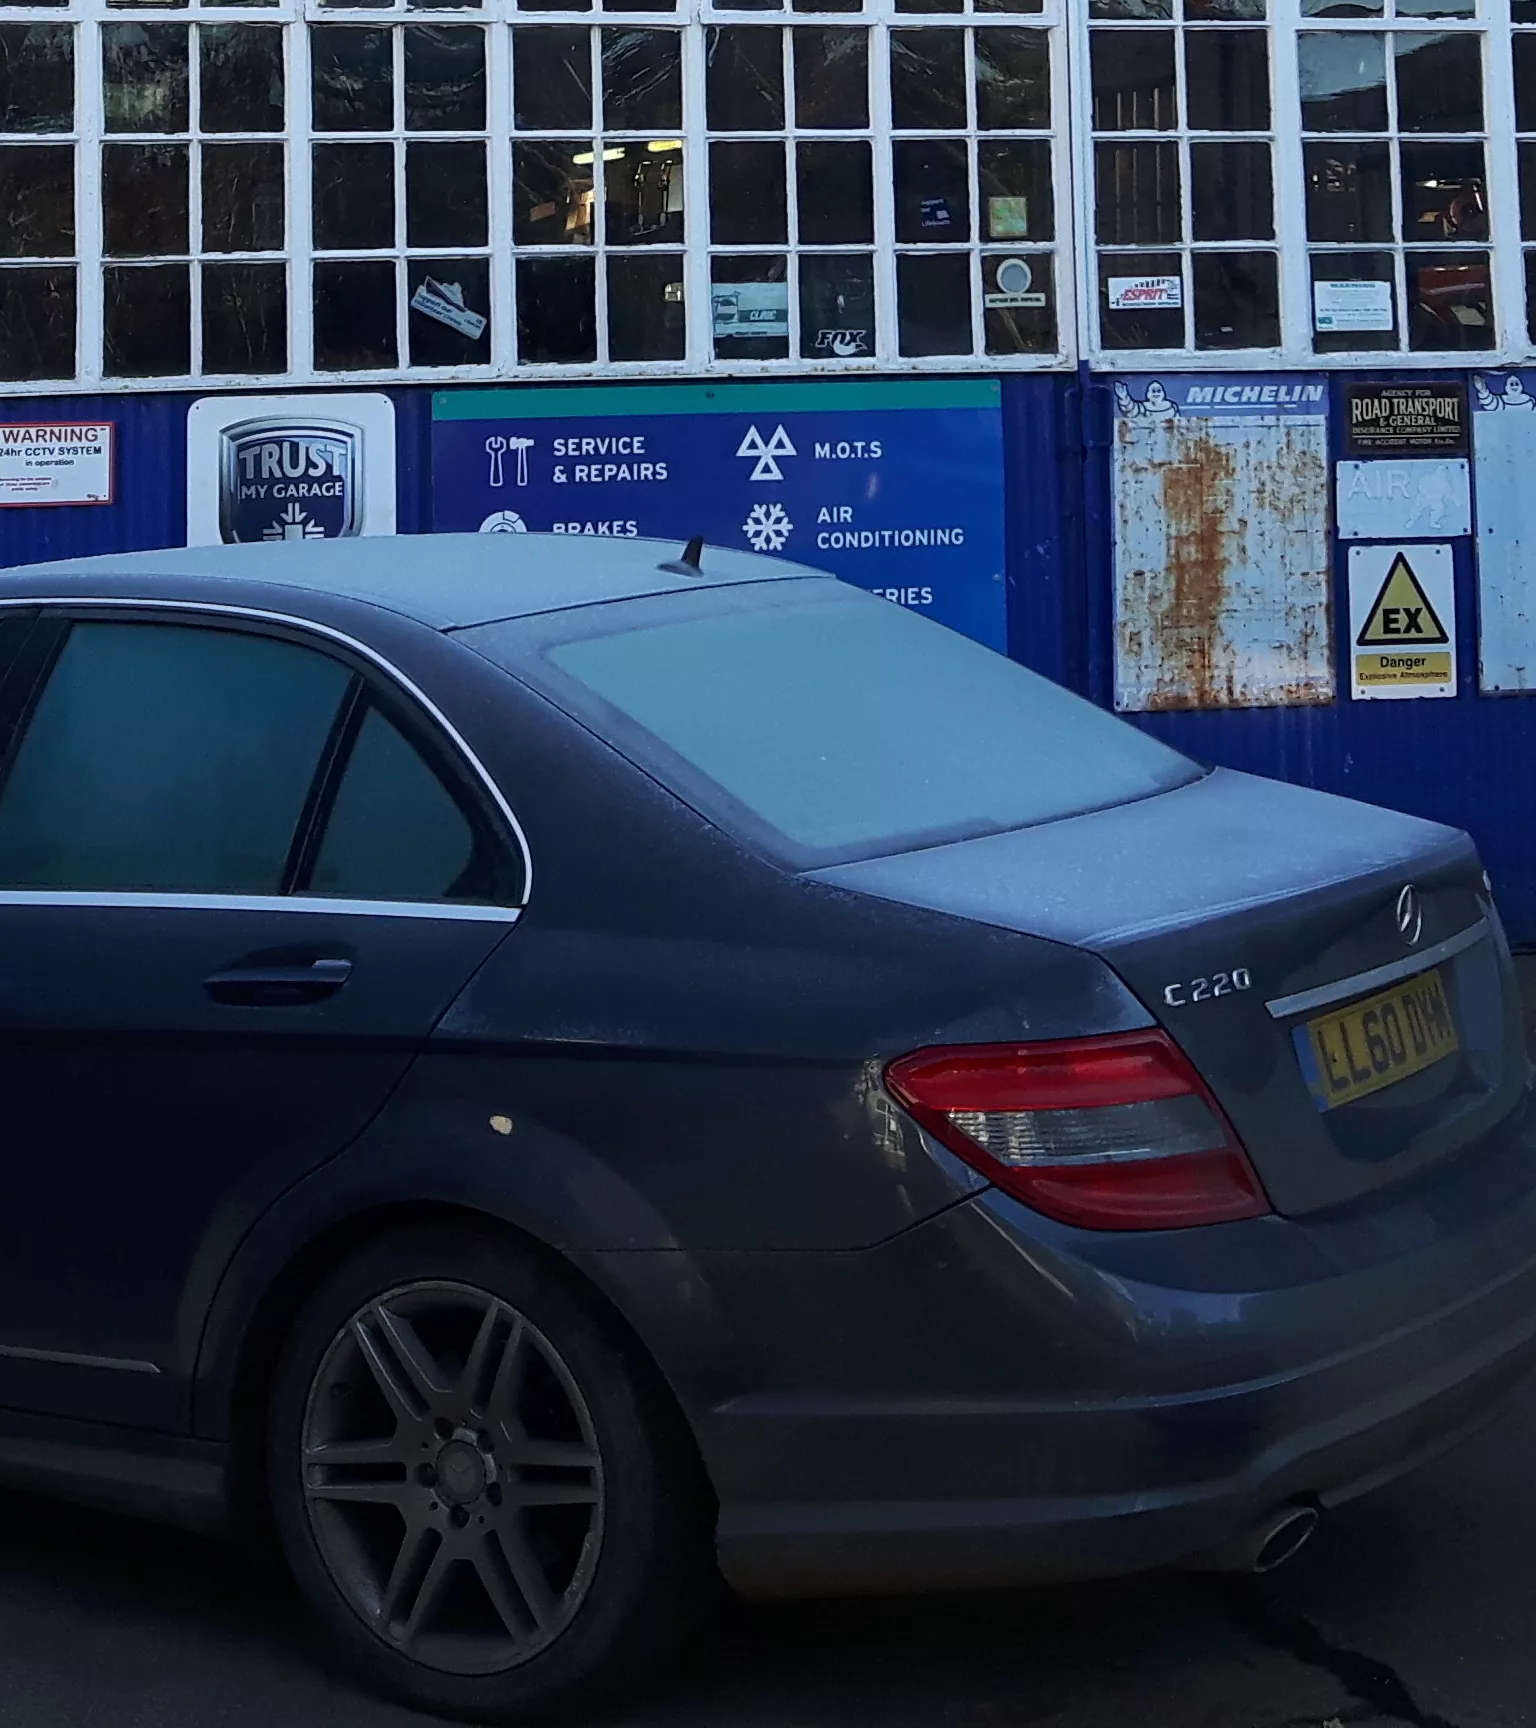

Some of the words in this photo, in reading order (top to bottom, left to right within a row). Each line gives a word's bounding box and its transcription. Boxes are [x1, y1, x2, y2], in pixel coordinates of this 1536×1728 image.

[816, 330, 867, 353] FOX
[1186, 384, 1325, 404] MICHELIN
[1351, 397, 1390, 425] ROAD
[1391, 397, 1459, 423] TRANSPORT
[1379, 416, 1388, 427] &
[1389, 415, 1437, 427] GENERAL
[2, 427, 99, 444] WARNING
[24, 446, 56, 457] CCTV
[58, 445, 102, 456] SYSTEM
[552, 436, 646, 457] SERVICE
[814, 440, 883, 460] M.O.T.S
[25, 459, 33, 467] in
[34, 458, 75, 468] operation
[238, 440, 348, 480] TRUST
[552, 465, 568, 484] &
[575, 462, 669, 483] REPAIRS
[240, 483, 269, 500] MY
[272, 481, 344, 499] GARAGE
[1347, 469, 1411, 502] AIR
[817, 505, 854, 524] AIR
[552, 519, 639, 538] BRAKES
[816, 527, 965, 550] CONDITIONING
[1382, 607, 1424, 635] EX
[1380, 656, 1427, 671] Danger
